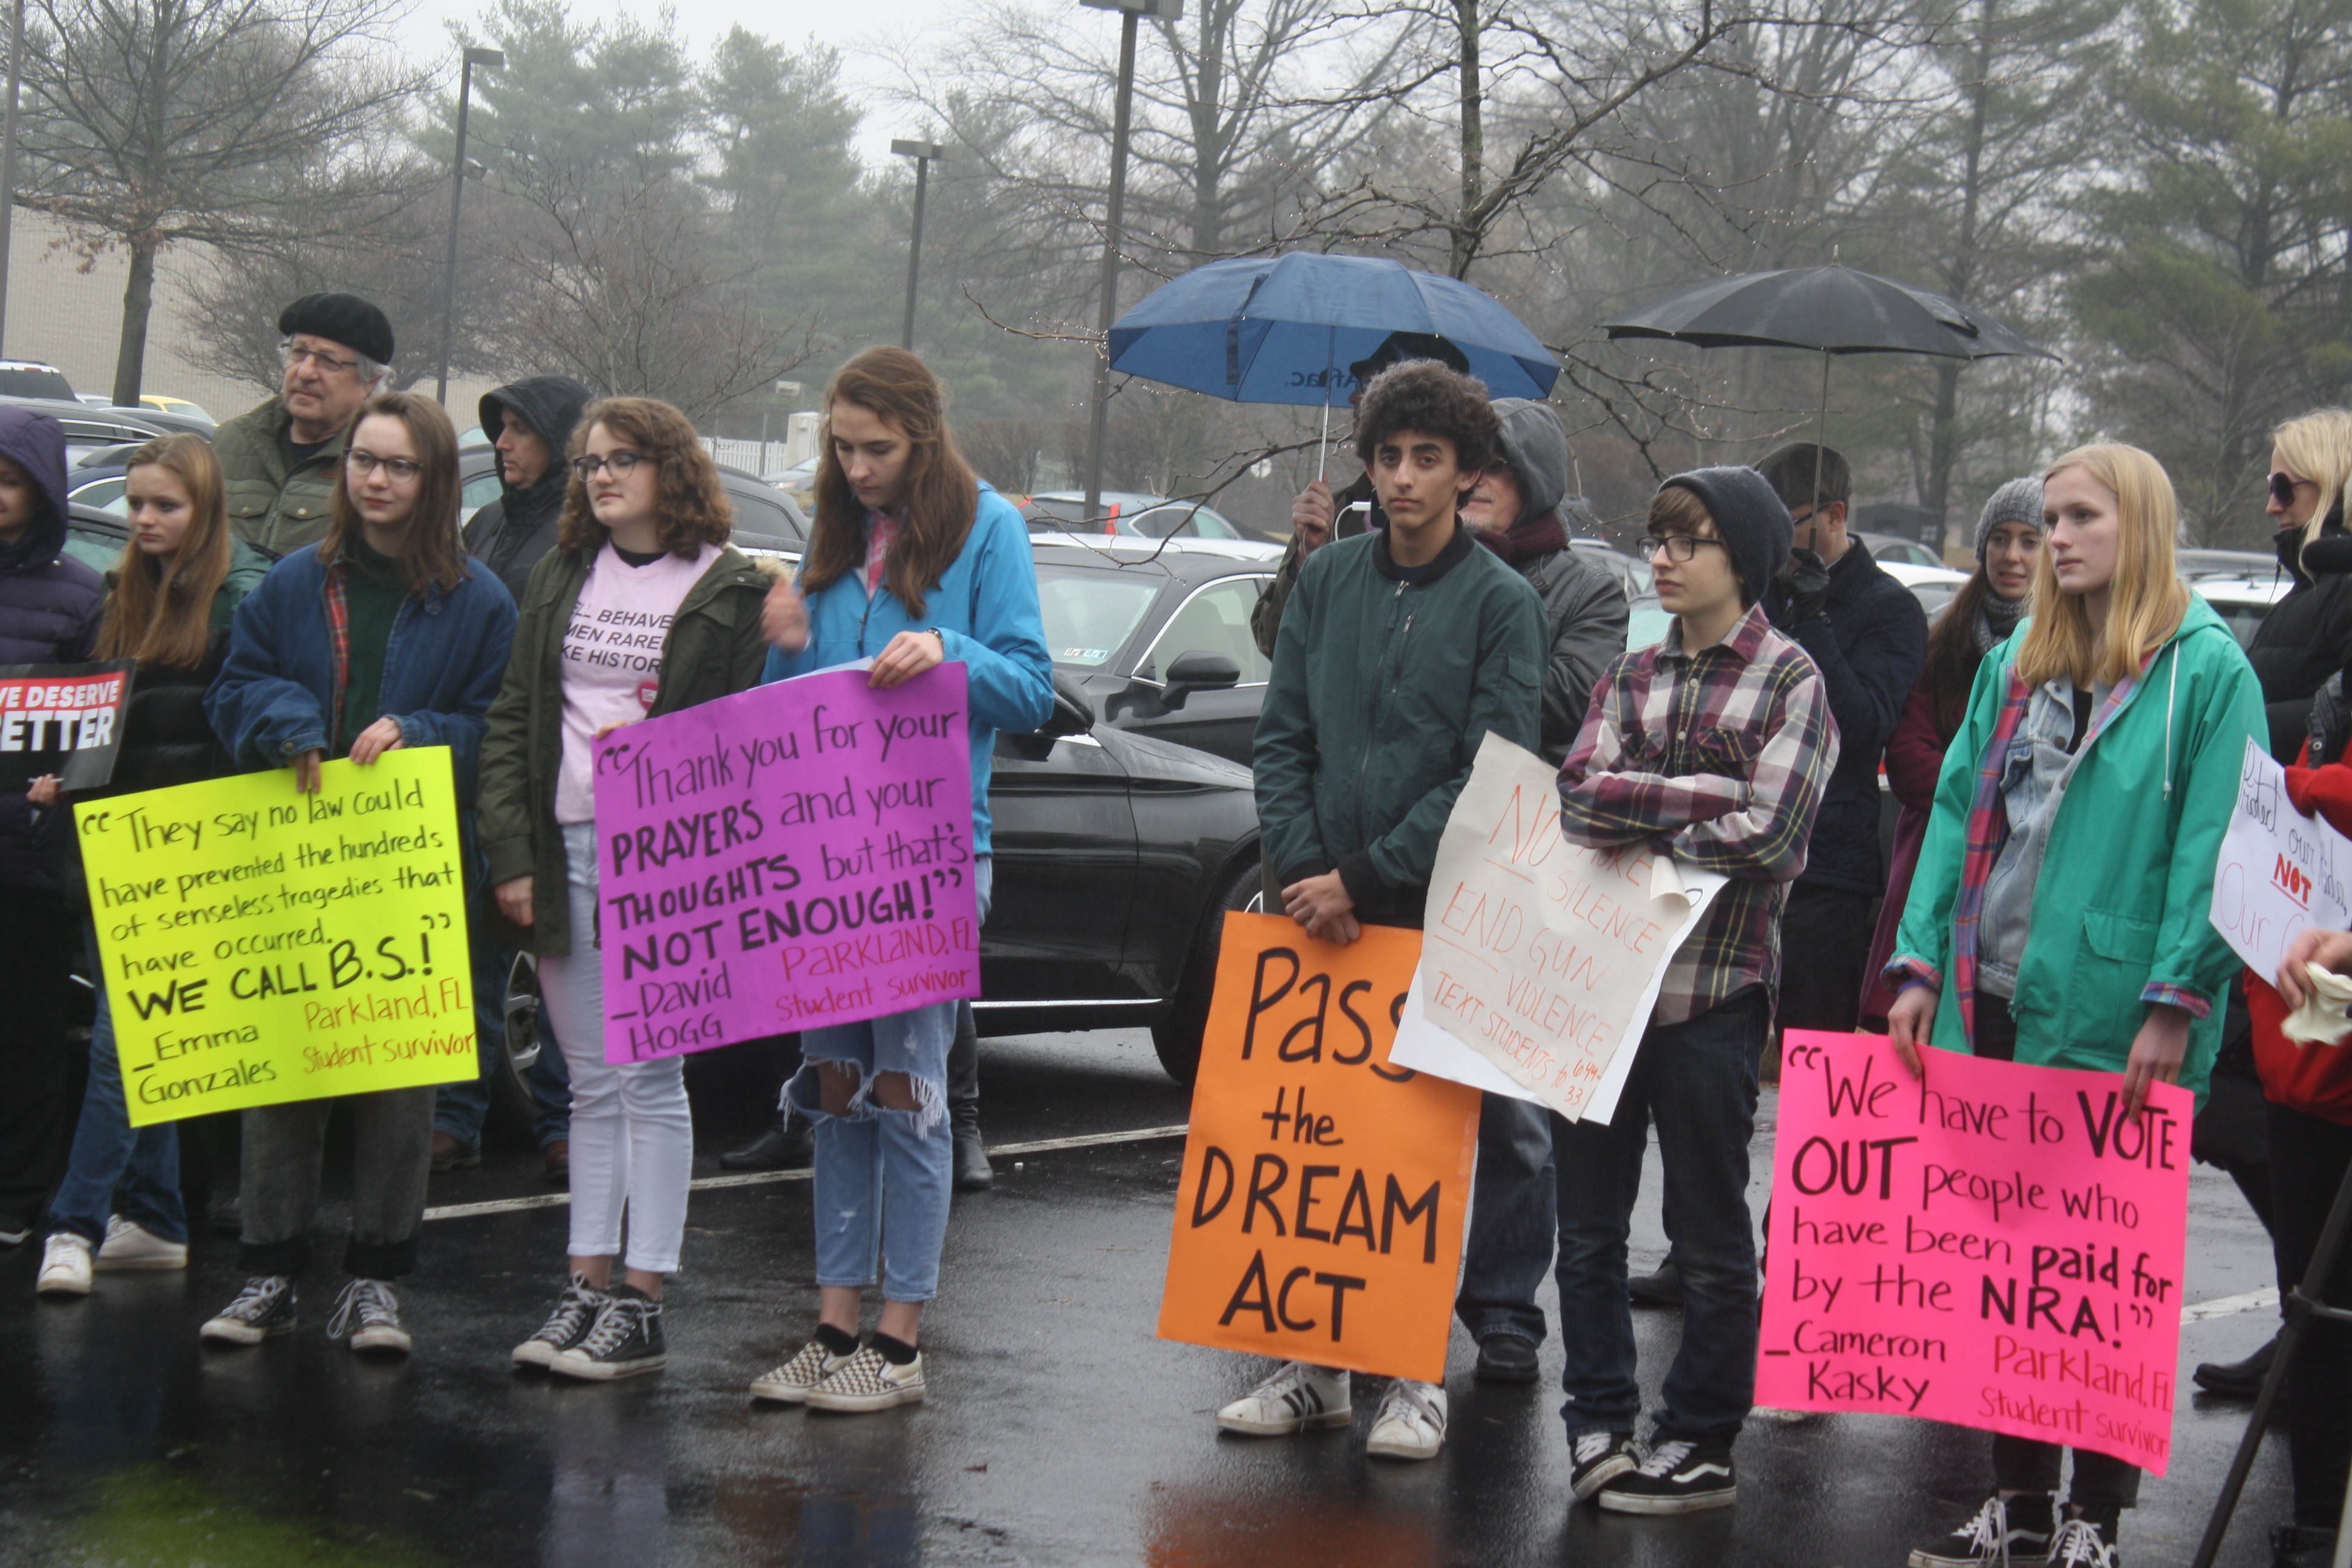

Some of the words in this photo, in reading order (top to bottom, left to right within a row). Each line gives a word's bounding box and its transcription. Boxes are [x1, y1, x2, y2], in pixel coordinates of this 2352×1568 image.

[606, 632, 665, 651] RARE
[25, 679, 120, 707] DESERVE
[0, 705, 116, 751] ETTER
[739, 732, 799, 788] you
[813, 705, 862, 753] for
[875, 711, 959, 762] your
[214, 812, 258, 840] say
[269, 803, 297, 827] no
[307, 788, 344, 824] law
[611, 799, 763, 877] PRAYERS
[780, 776, 856, 825] and
[866, 777, 946, 826] your
[100, 877, 169, 907] have
[179, 853, 285, 902] prevented
[295, 843, 335, 870] the
[339, 825, 443, 862] hundreds
[608, 854, 801, 930] THOUGHTS
[820, 837, 875, 881] but
[881, 823, 968, 871] that's
[2273, 852, 2311, 904] NOT
[111, 915, 146, 941] of
[157, 895, 274, 930] senseless
[278, 879, 383, 909] tragedies
[393, 862, 454, 889] that
[1547, 871, 1662, 954] SILENCE
[121, 947, 199, 979] have
[214, 918, 333, 959] occurred.
[622, 921, 723, 980] NOT
[952, 916, 978, 953] FL
[1442, 881, 1523, 953] END
[1529, 927, 1609, 991] GUN
[128, 979, 208, 1021] WE
[230, 962, 317, 1001] CALL
[440, 976, 469, 1013] FL
[775, 977, 874, 1021] Student
[1241, 947, 1417, 1083] Pass
[1506, 972, 1612, 1057] VIOLENCE
[302, 1034, 377, 1073] Student
[629, 1013, 723, 1059] HOGG
[1434, 970, 1485, 1024] TEXT
[1481, 1011, 1555, 1081] STUDENTS
[138, 1059, 276, 1105] Gonzales
[1564, 1085, 1583, 1105] 33
[1262, 1085, 1343, 1145] the
[1919, 1065, 2008, 1141] have
[2017, 1092, 2064, 1144] to
[2077, 1091, 2177, 1171] VOTE
[1191, 1146, 1440, 1264] DREAM
[1791, 1135, 1919, 1200] OUT
[1922, 1164, 2049, 1222] people
[2062, 1183, 2138, 1229] who
[1792, 1206, 1889, 1245] have
[1906, 1215, 2011, 1264] been
[2031, 1243, 2119, 1289] paid
[2132, 1252, 2173, 1303] for
[1218, 1249, 1365, 1342] ACT
[1792, 1259, 1843, 1313] by
[1858, 1264, 1953, 1312] the
[1808, 1361, 1930, 1411] Kasky
[1978, 1387, 2090, 1434] Student
[2152, 1371, 2172, 1413] FL
